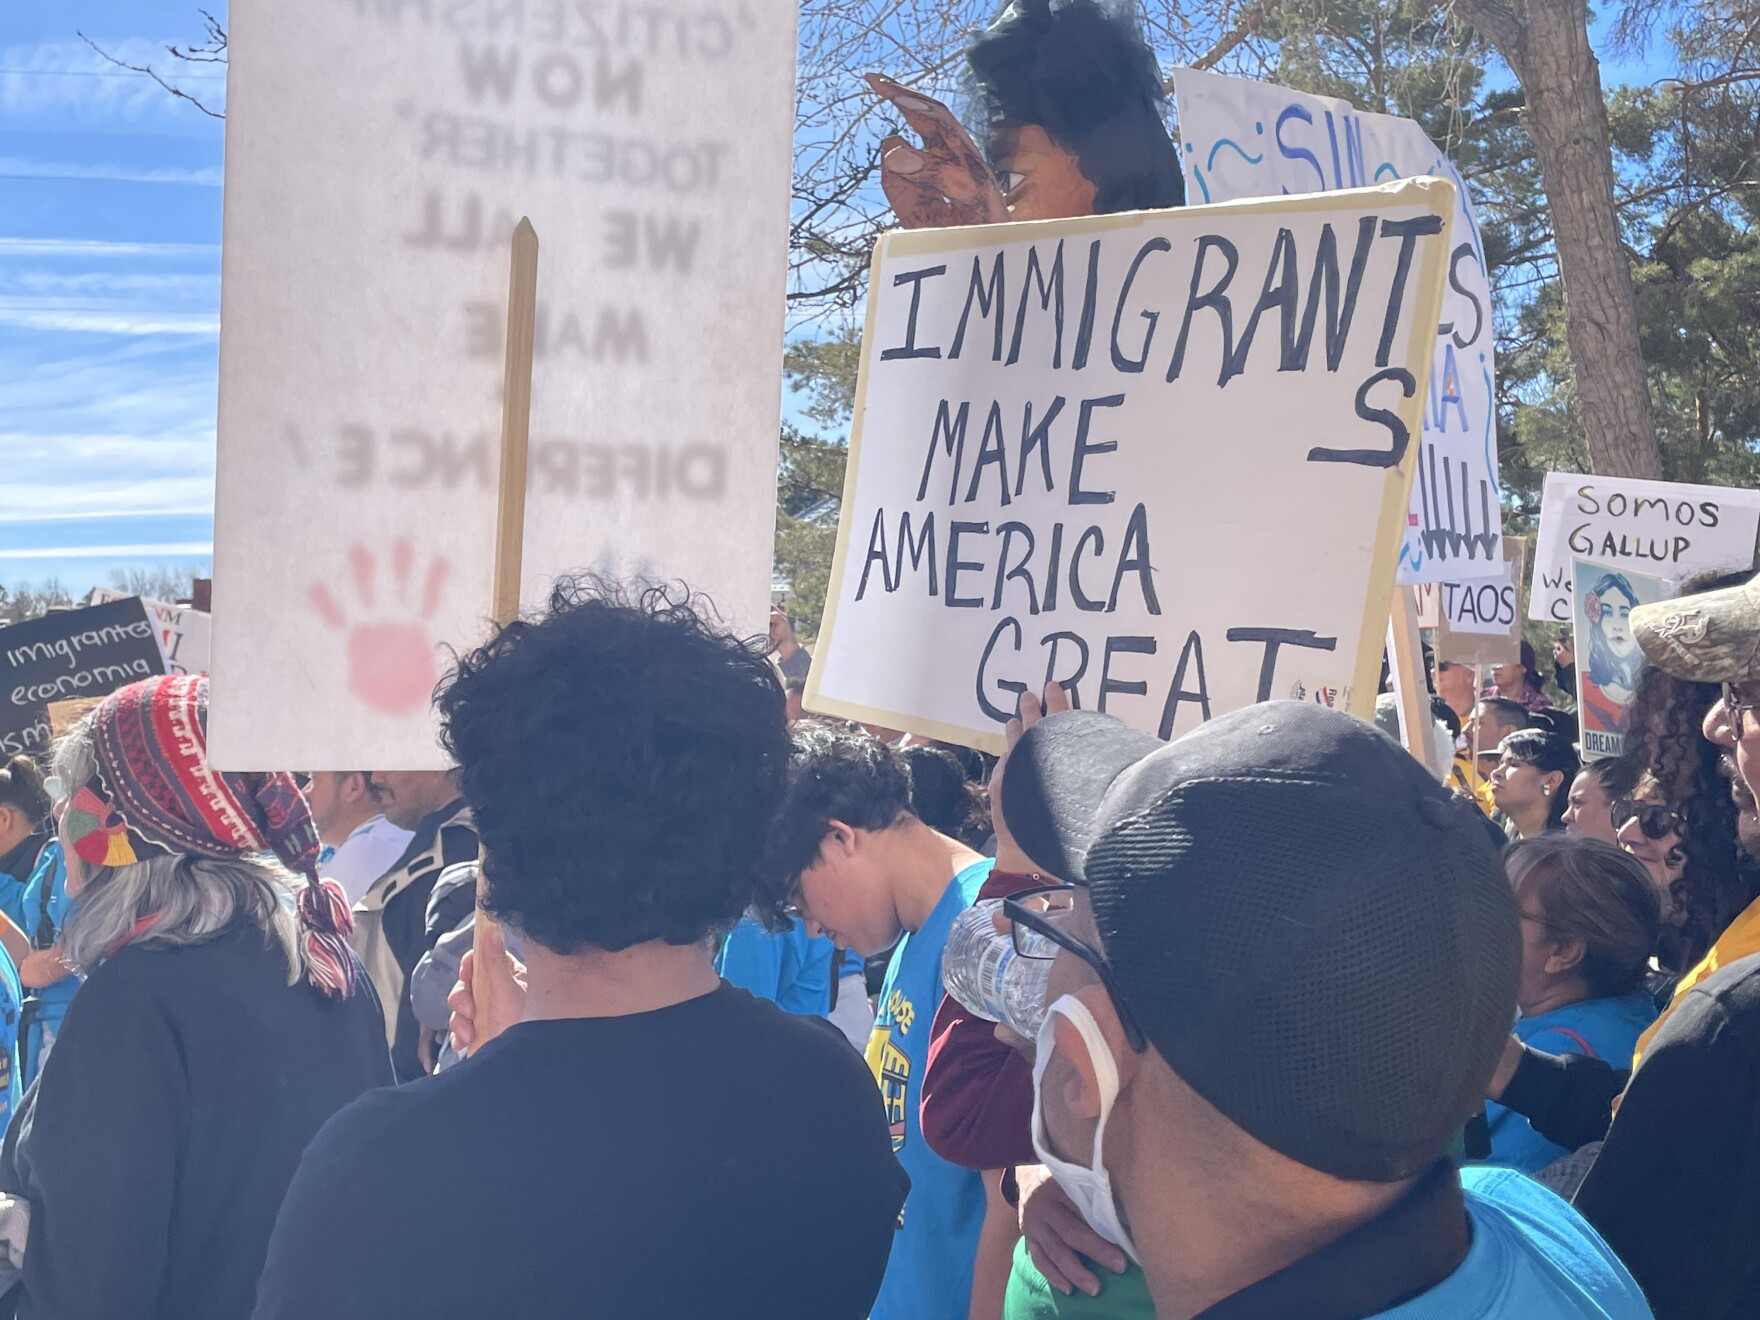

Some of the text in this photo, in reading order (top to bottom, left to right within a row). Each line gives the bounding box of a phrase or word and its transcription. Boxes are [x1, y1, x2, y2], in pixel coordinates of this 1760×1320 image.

[917, 393, 1126, 506] MAKE
[855, 503, 1162, 616] AMERICA
[1568, 523, 1691, 563] GALLUP
[1444, 582, 1515, 625] TAOS
[11, 658, 150, 705] economia
[976, 616, 1337, 741] GREAT
